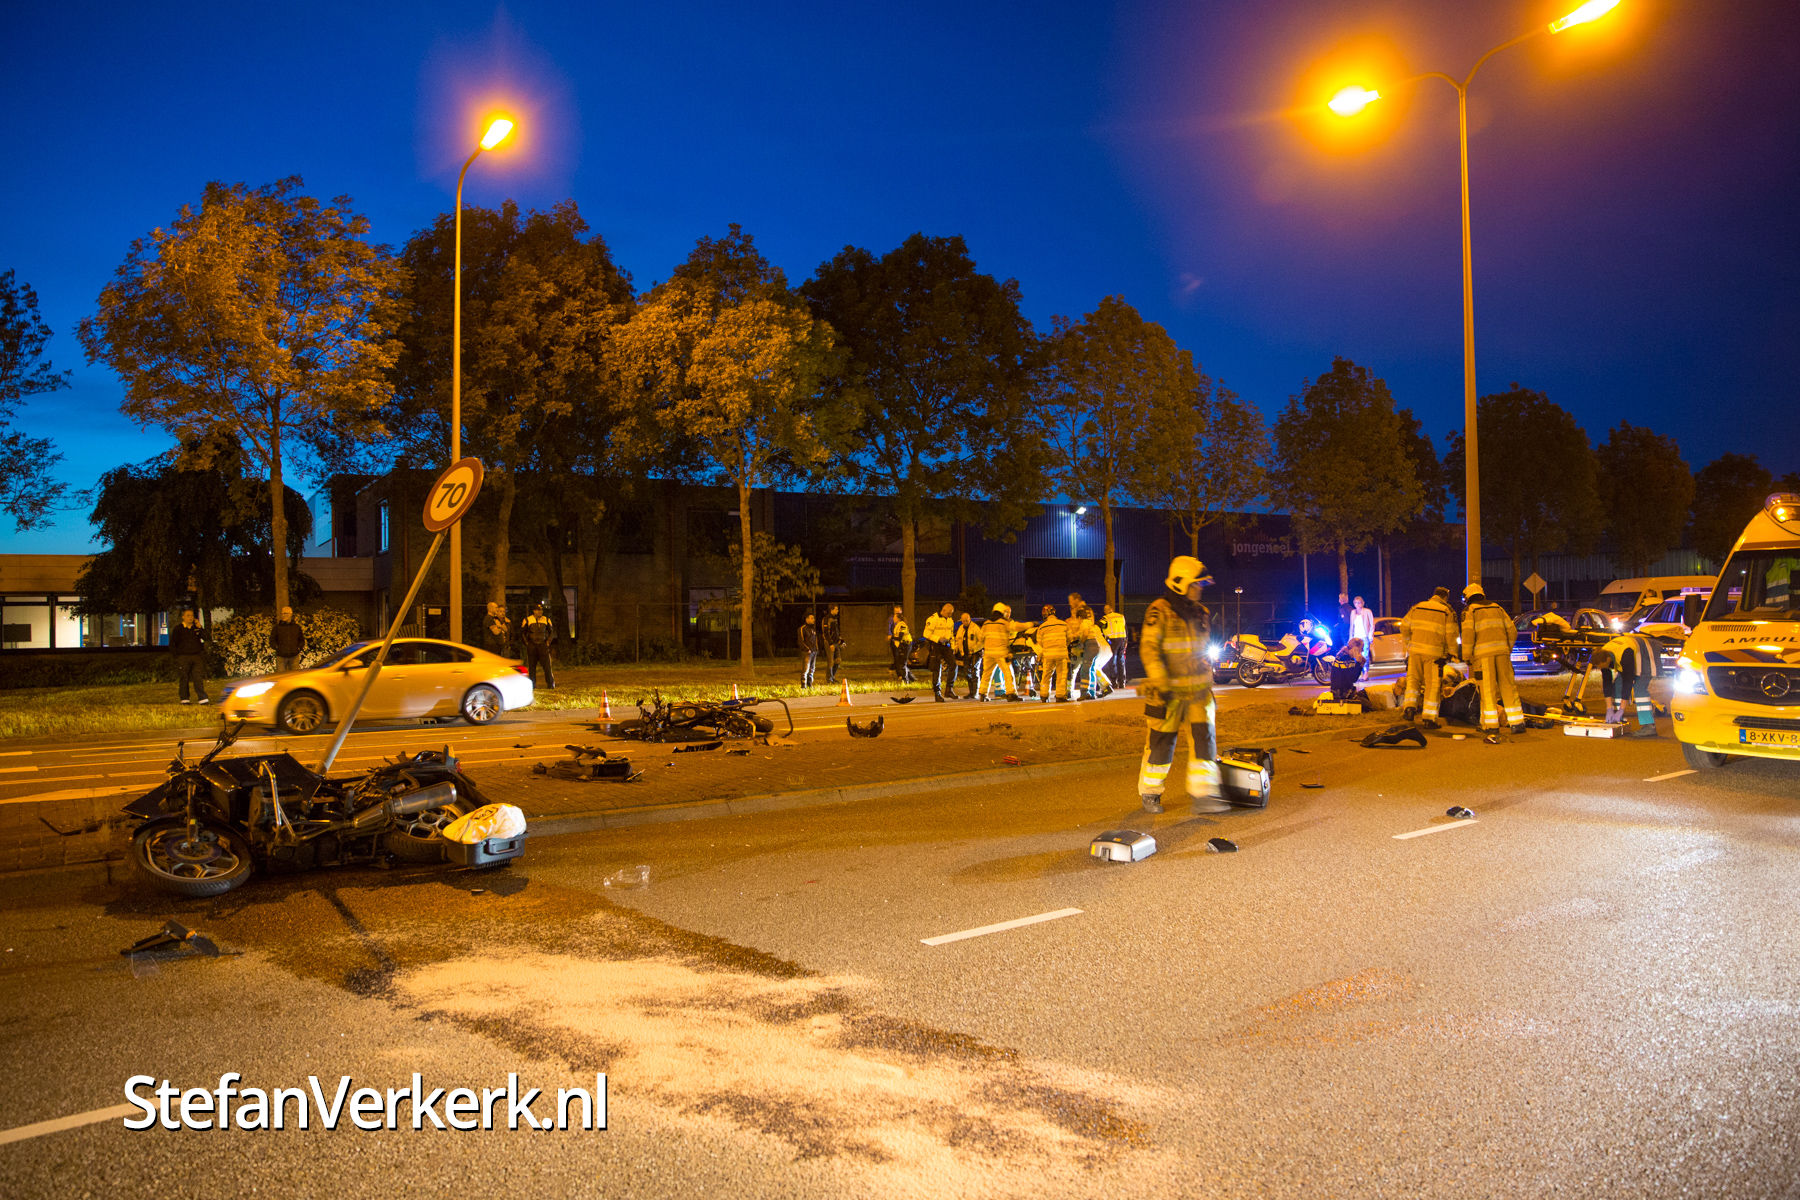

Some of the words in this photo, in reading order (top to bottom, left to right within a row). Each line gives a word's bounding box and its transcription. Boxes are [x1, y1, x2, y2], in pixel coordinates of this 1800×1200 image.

[436, 482, 467, 508] 70
[1232, 539, 1290, 557] jongenel
[1750, 732, 1800, 743] 8-XKV-8
